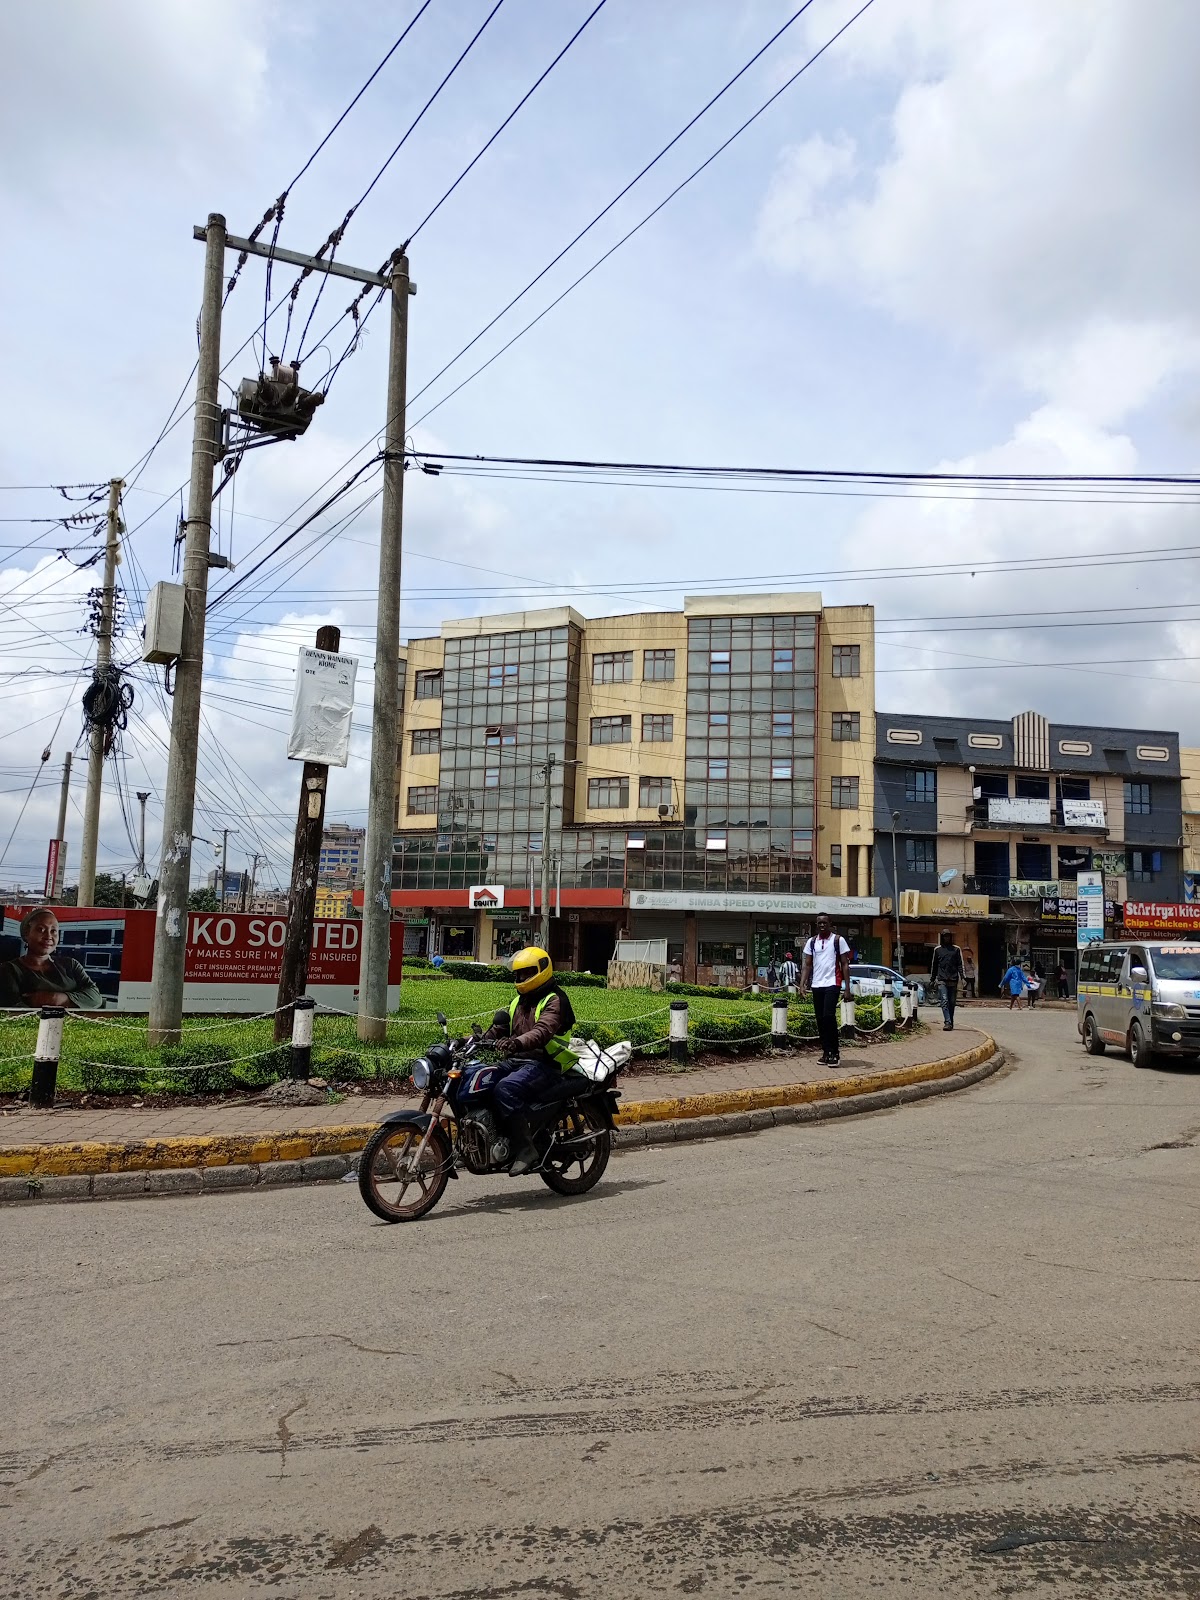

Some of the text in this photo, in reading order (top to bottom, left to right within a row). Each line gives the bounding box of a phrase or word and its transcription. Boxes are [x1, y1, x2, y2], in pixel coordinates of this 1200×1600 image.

[305, 650, 326, 660] DENNIS
[647, 896, 678, 904] SIMBA
[689, 898, 817, 909] SIMBA SPEED GOVERNOR
[945, 896, 970, 908] AVL
[1058, 906, 1077, 915] SAL
[1125, 919, 1150, 928] Chips
[1153, 919, 1188, 928] Chicken
[185, 917, 359, 949] IKO SOTED
[1153, 930, 1181, 938] kitchen
[196, 949, 232, 959] MAKES
[234, 949, 261, 960] SURE
[264, 950, 278, 960] I'M
[320, 952, 358, 962] INSURED
[208, 963, 246, 971] INSURANCE
[247, 964, 277, 972] PREMIUM
[212, 971, 249, 979] INSURANCE
